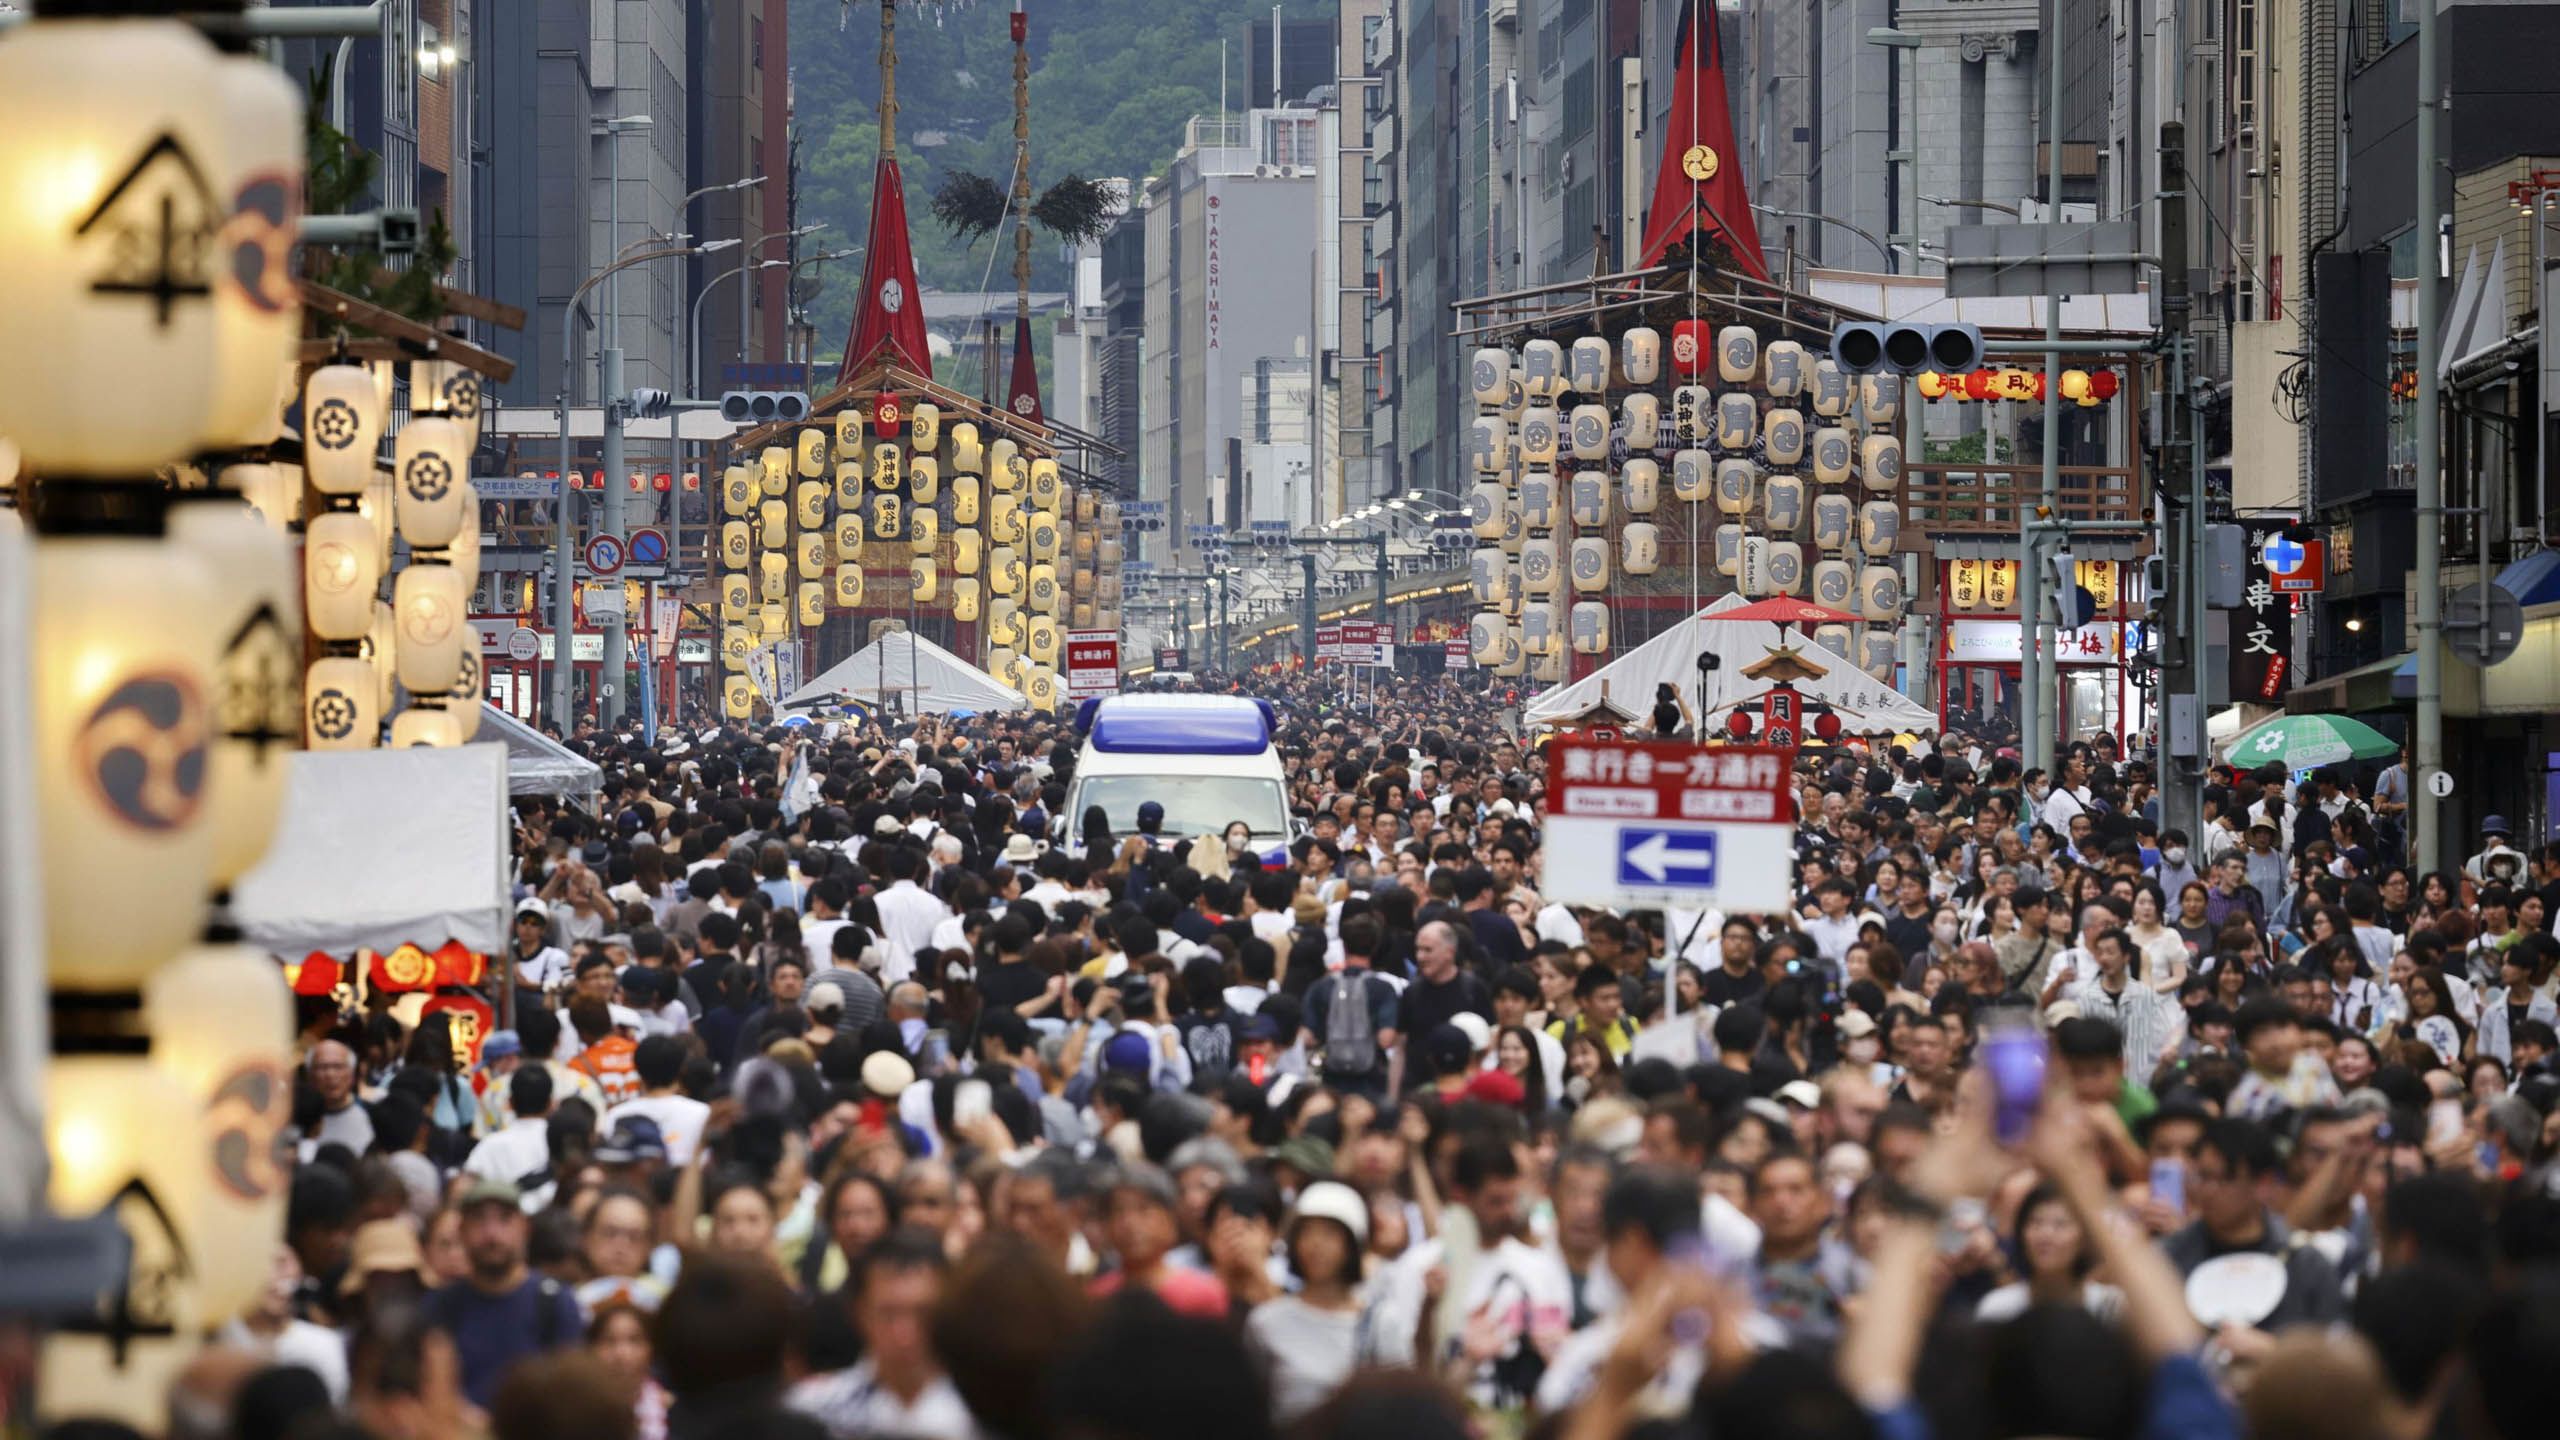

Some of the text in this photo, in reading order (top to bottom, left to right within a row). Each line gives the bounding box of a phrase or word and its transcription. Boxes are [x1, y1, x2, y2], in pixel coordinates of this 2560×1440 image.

[1208, 214, 1219, 348] TAKASHIMAYA
[1677, 390, 1695, 439] 御神燈
[882, 447, 896, 486] 御神燈
[2243, 579, 2279, 654] 串文
[1770, 695, 1795, 748] 月鉾
[1562, 747, 1781, 788] 東行き一方通行
